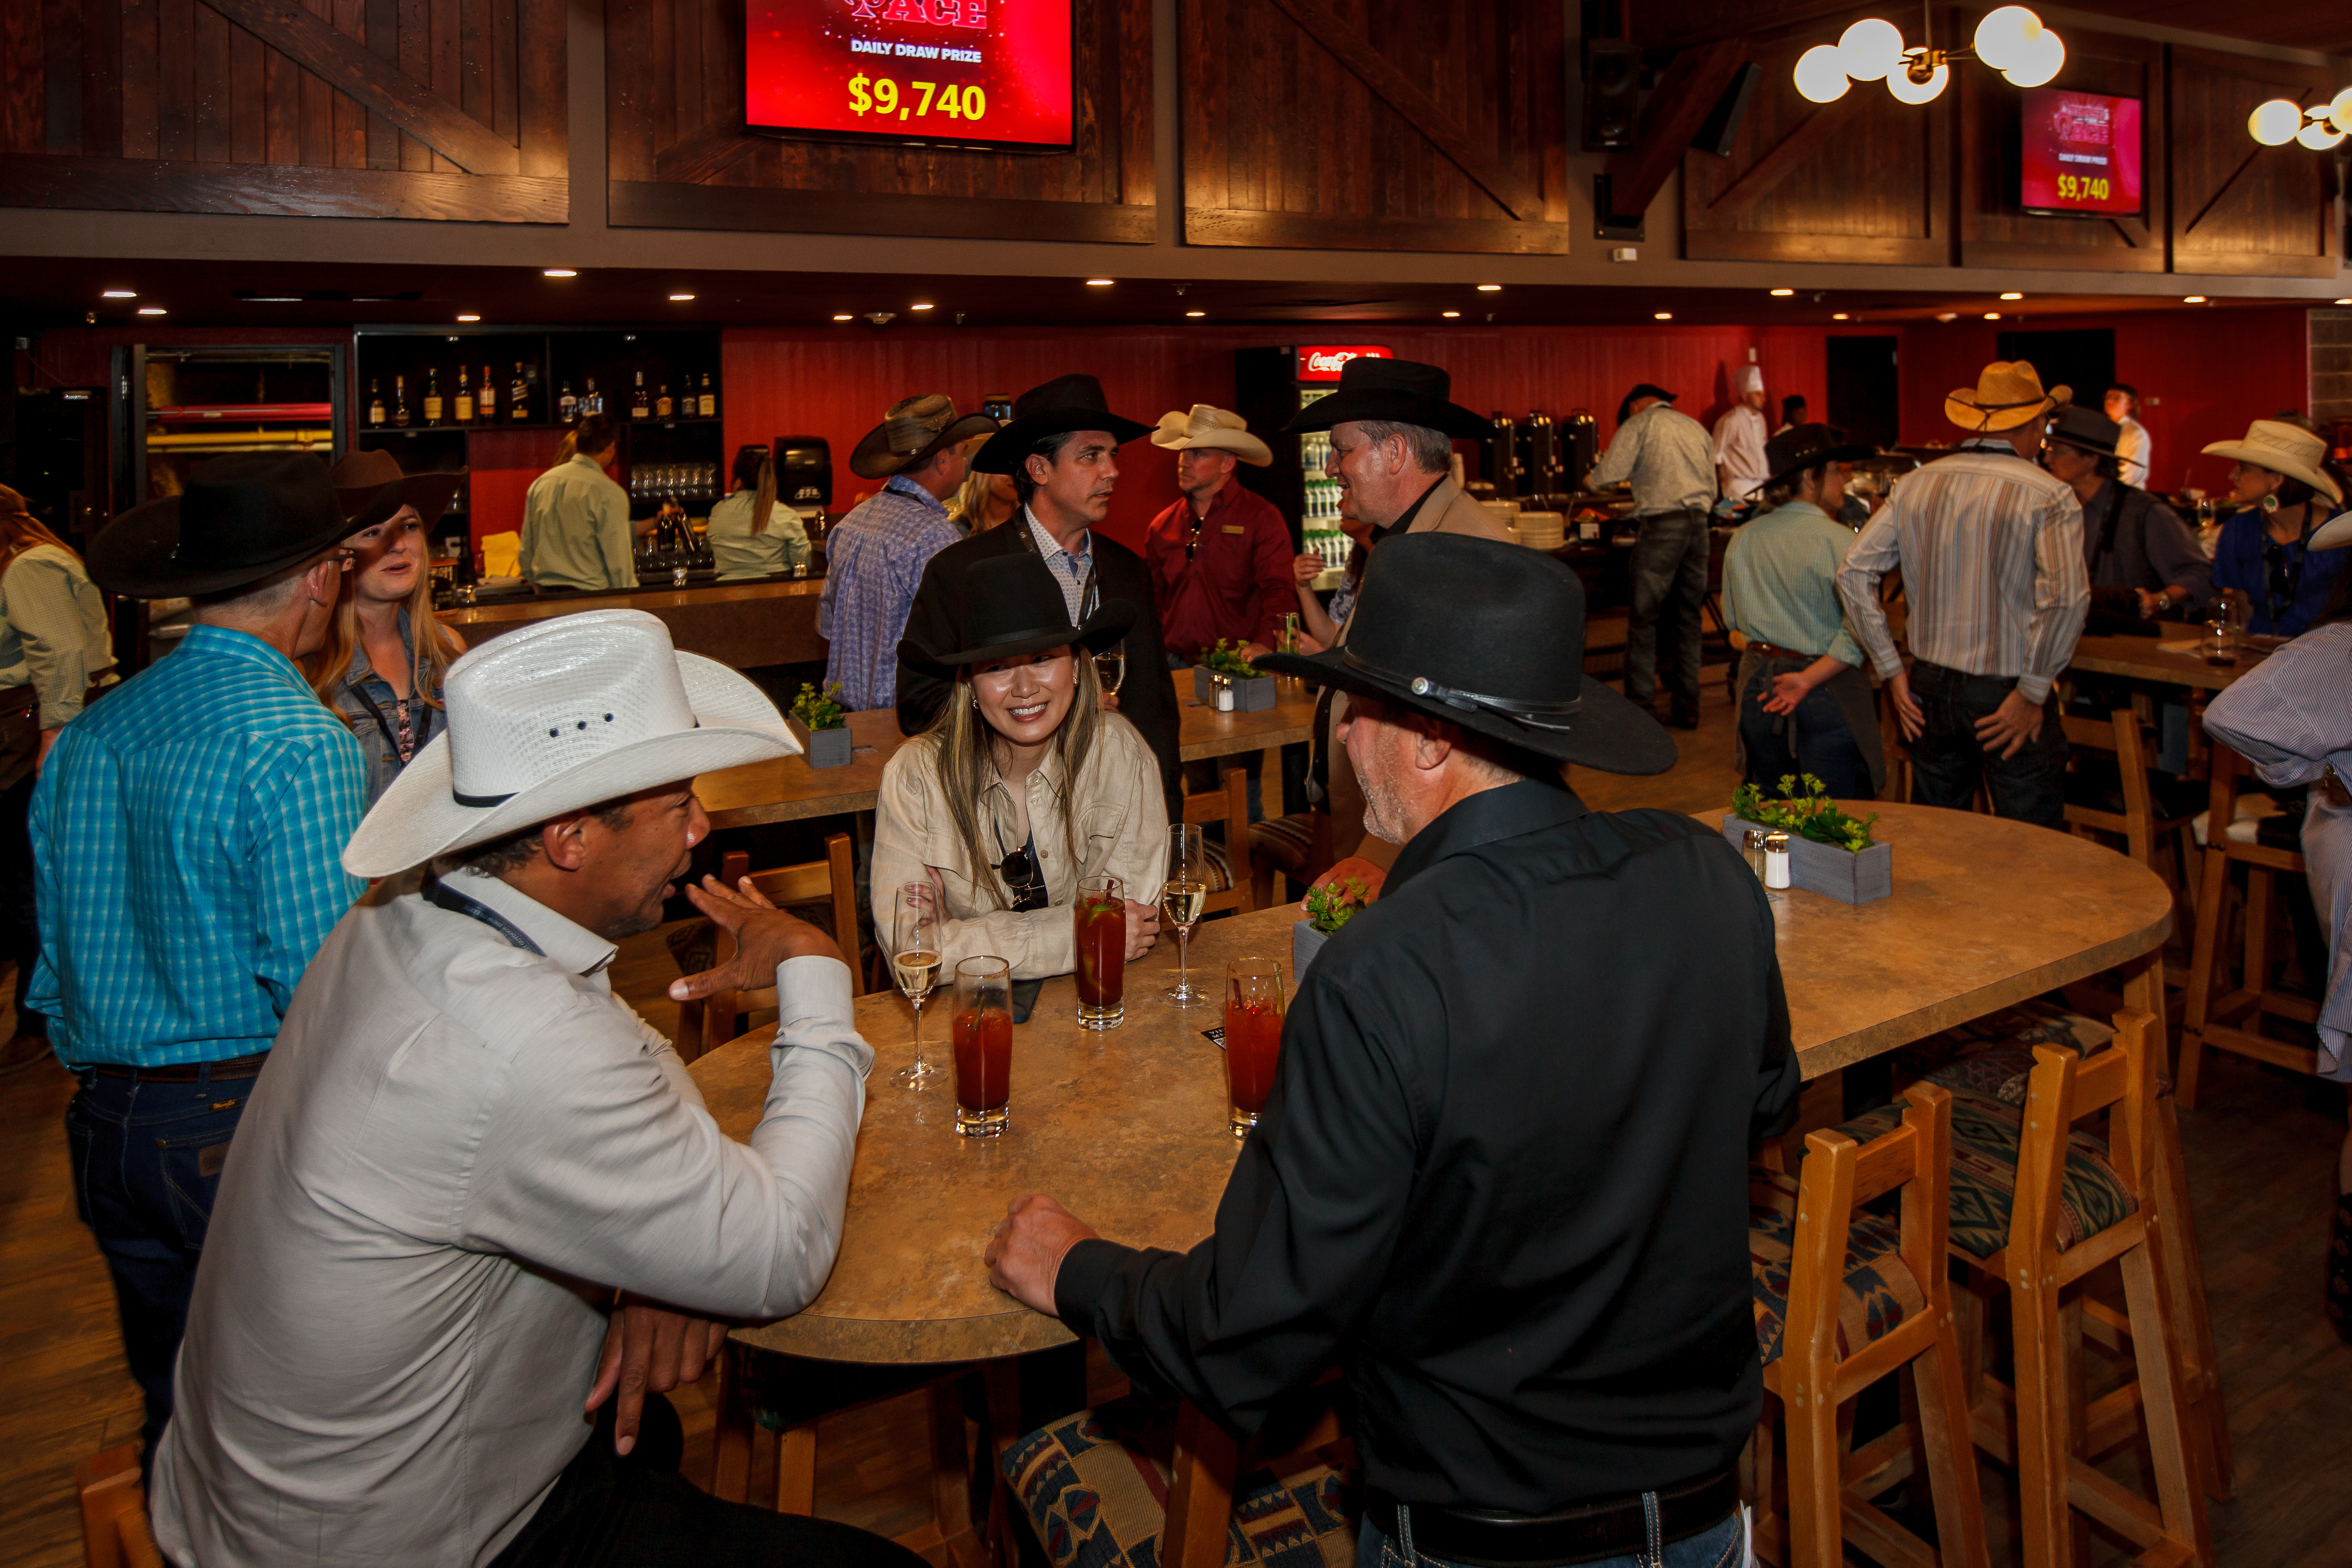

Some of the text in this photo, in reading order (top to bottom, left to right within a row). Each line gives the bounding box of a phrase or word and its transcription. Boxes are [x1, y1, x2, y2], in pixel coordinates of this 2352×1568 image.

[851, 39, 982, 63] DAILY DRAW PRIZE
[848, 72, 986, 121] $9,740
[2058, 172, 2110, 201] $9,740
